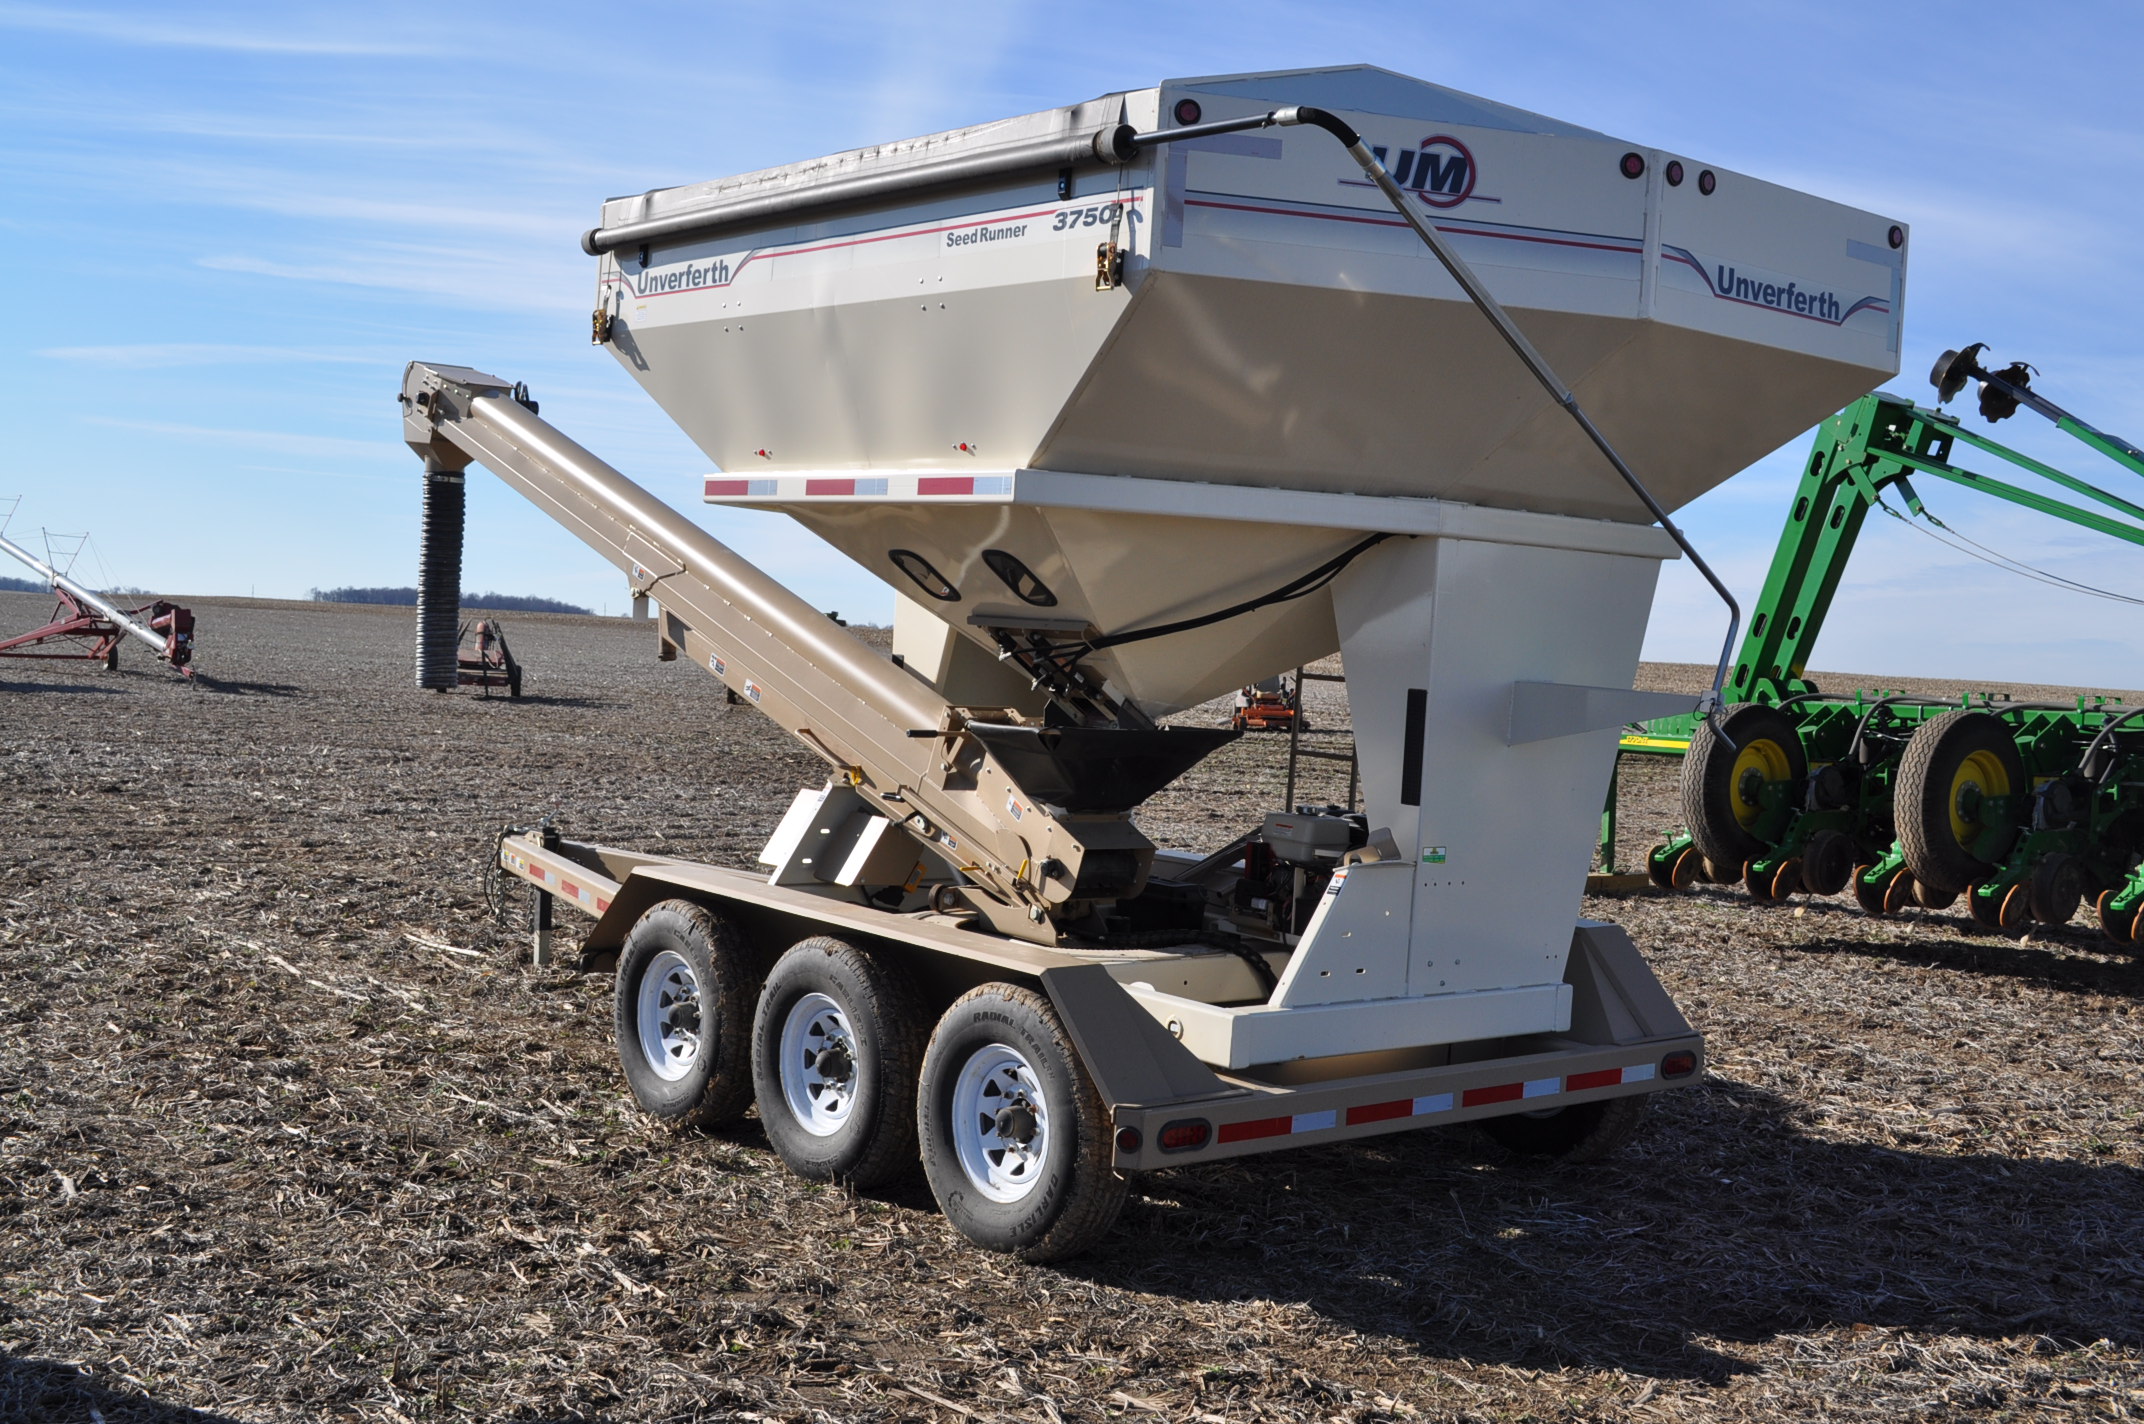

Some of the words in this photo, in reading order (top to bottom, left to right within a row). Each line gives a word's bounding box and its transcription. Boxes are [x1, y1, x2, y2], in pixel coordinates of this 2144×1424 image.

[1372, 146, 1468, 194] UM
[946, 228, 978, 248] Seed
[979, 224, 1028, 243] Runner
[637, 258, 729, 295] Unverferth
[1717, 264, 1840, 321] Unverferth
[762, 983, 782, 1018] TRAIL
[973, 1011, 1016, 1030] RADIAL
[1019, 1028, 1049, 1071] TRAIL
[1010, 1173, 1060, 1238] CARLISLE
